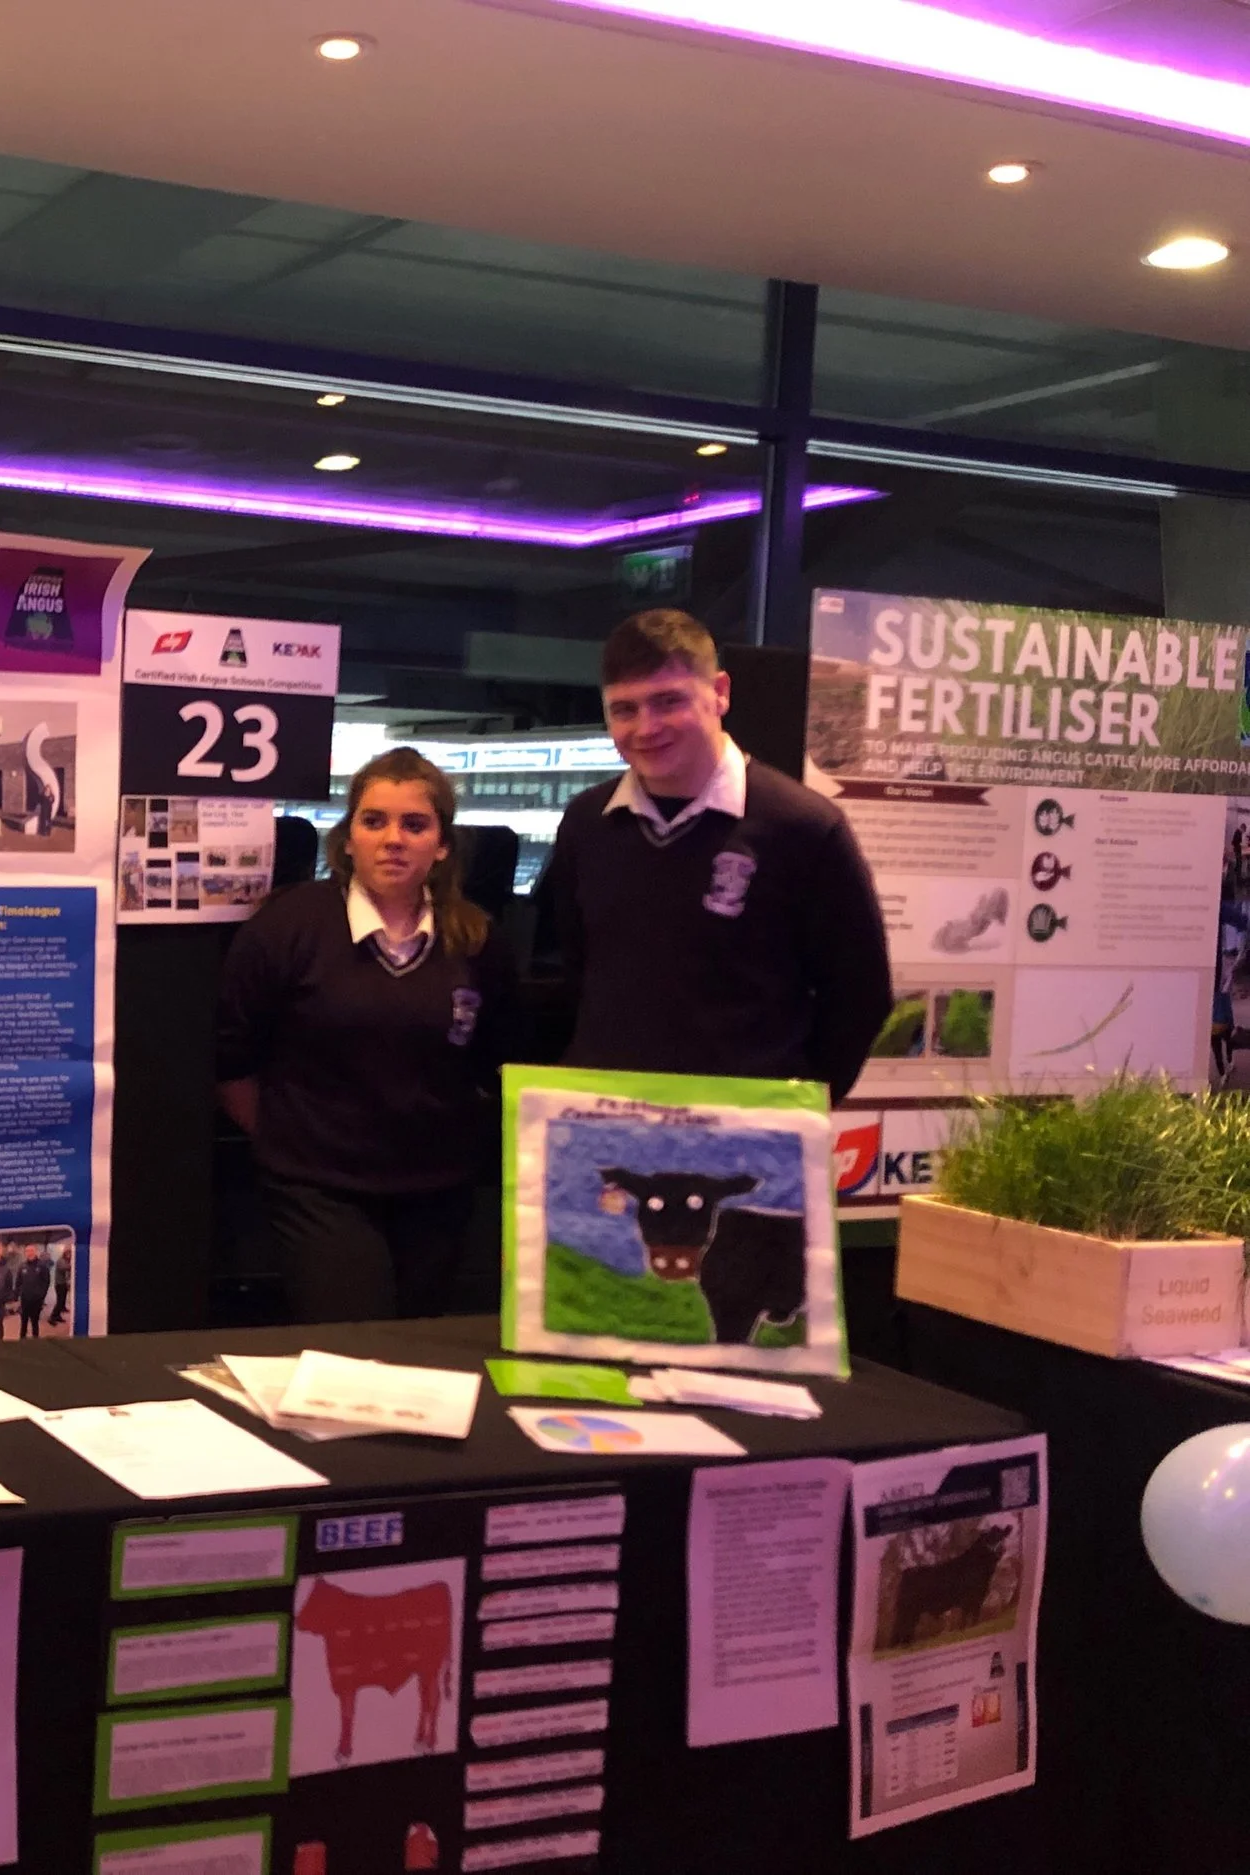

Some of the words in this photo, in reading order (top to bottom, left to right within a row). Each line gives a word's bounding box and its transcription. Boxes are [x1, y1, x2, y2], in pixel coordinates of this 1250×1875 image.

[16, 593, 64, 614] ANGUS
[23, 582, 62, 598] IRISH
[869, 607, 1238, 691] SUSTAINABLE
[865, 674, 1160, 747] FERTILISER
[177, 700, 279, 782] 23
[862, 758, 899, 772] AND
[902, 760, 943, 775] HELP
[978, 764, 1085, 784] ENVIRONMENT
[865, 741, 887, 754] TO
[940, 745, 1027, 763] PRODUCING
[1031, 750, 1081, 767] ANGUS
[1140, 755, 1181, 771] MORE
[1184, 758, 1250, 775] AFFORDA
[883, 1150, 934, 1185] KE
[1158, 1277, 1210, 1298] Liquid
[1141, 1303, 1222, 1326] Seaweed
[321, 1519, 403, 1546] BEEF
